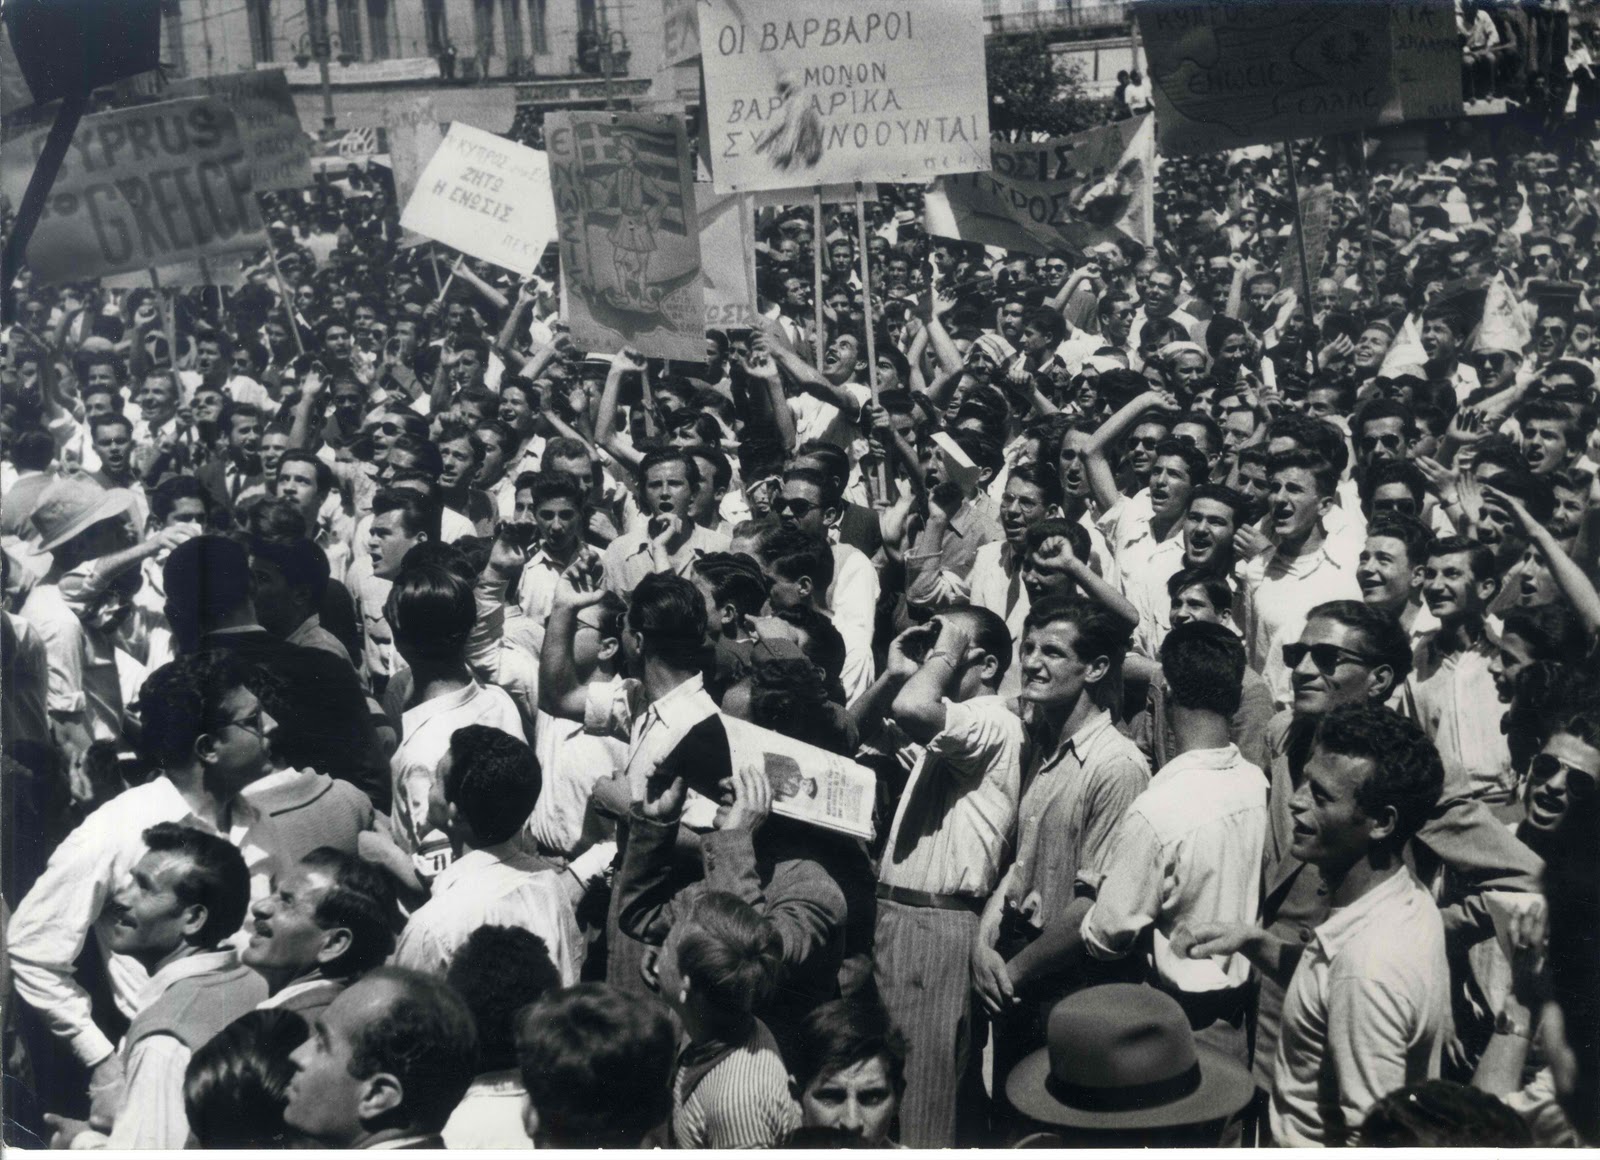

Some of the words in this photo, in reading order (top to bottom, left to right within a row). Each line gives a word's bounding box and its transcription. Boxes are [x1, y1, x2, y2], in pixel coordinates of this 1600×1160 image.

[719, 25, 746, 56] ΟΙ
[760, 11, 913, 53] ΒΑΡΒΑΡΟΙ
[804, 62, 887, 88] ΜΟΝΟΝ
[727, 89, 902, 123] ΒΑΡΑΡΙΚΑ
[723, 115, 979, 158] ΣΥΝΟΟΥΝΤΑΙ
[459, 166, 505, 193] ΖΗΤΩ
[991, 144, 1076, 182] ΩΣΙΣ
[84, 150, 262, 264] GREECE
[432, 179, 448, 196] Η
[449, 187, 515, 223] ΕΝΩΣΙΣ
[704, 303, 753, 325] ΩΣΙΣ
